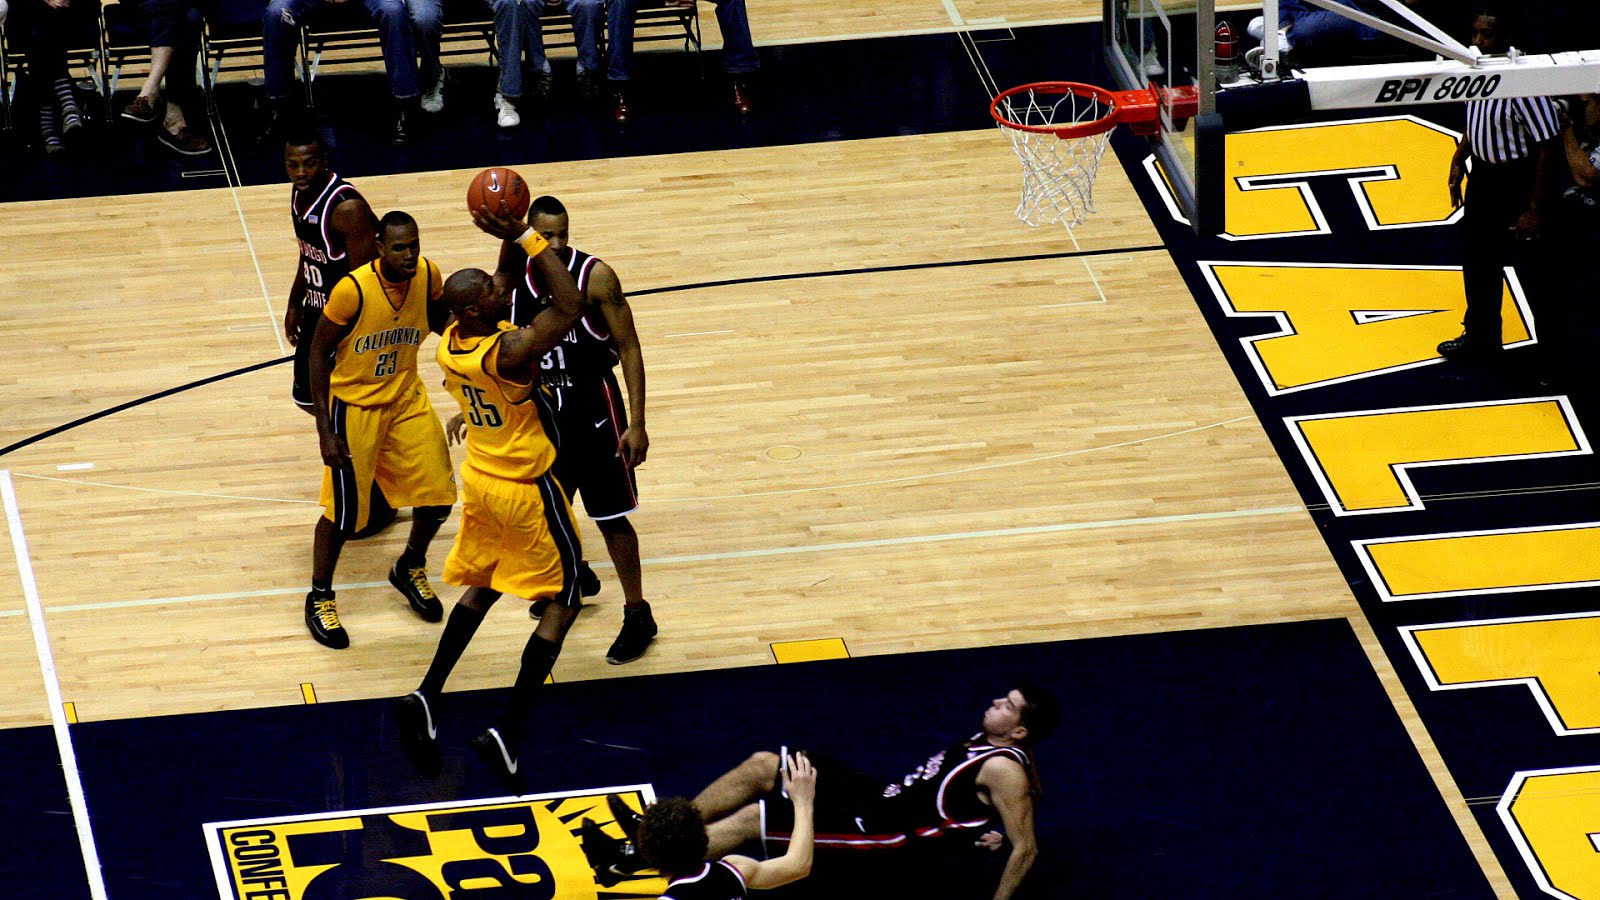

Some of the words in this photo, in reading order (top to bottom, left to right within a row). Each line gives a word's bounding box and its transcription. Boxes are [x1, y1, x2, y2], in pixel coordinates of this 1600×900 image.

[1375, 78, 1432, 103] BPI
[1434, 74, 1502, 101] 8000
[304, 261, 323, 287] 40
[354, 326, 421, 354] CALIFORNIA
[374, 350, 399, 377] 23
[540, 345, 566, 370] 31
[461, 384, 504, 429] 35
[1143, 115, 1600, 900] CALIF
